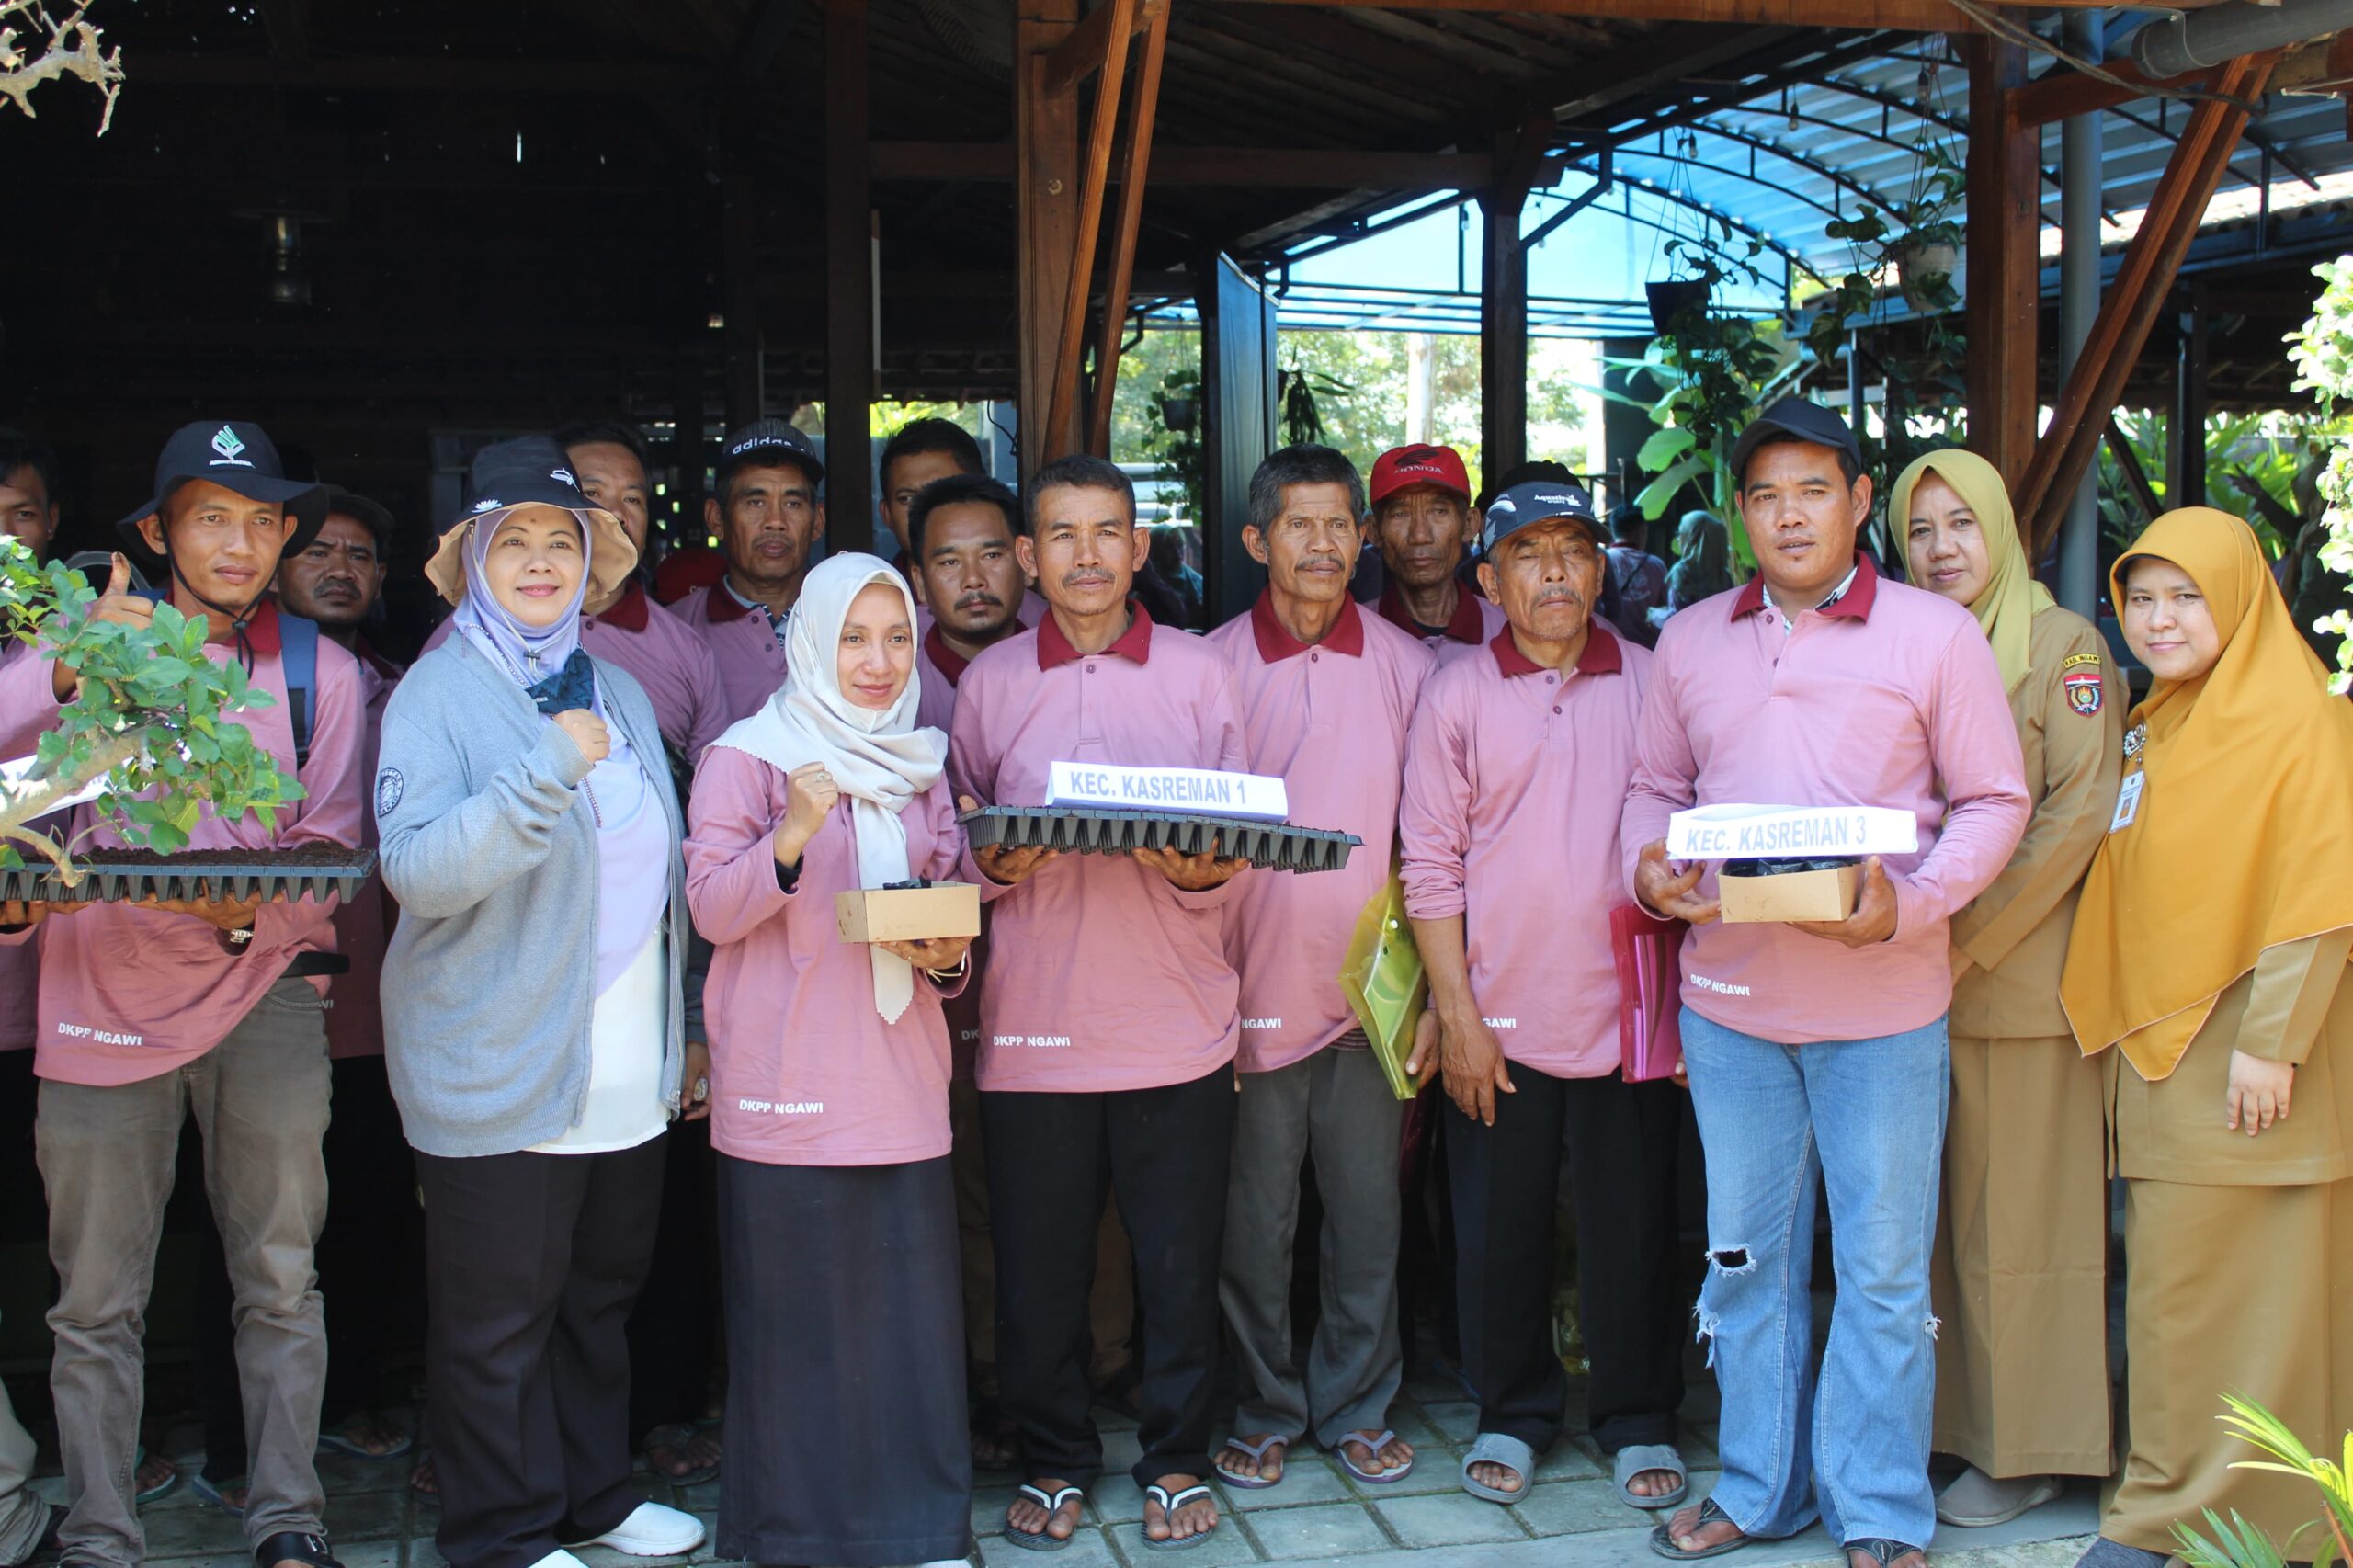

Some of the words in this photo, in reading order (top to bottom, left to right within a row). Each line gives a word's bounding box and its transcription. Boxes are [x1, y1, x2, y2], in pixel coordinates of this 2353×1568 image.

[1070, 771, 1116, 797] KEC.
[1121, 774, 1231, 804] KASREMAN
[1236, 779, 1246, 804] 1
[1685, 828, 1731, 852] KEC.
[1738, 815, 1848, 851] KASREMAN
[1855, 815, 1867, 845] 3
[1711, 981, 1751, 996] NGAWI
[1241, 1017, 1282, 1029] NGAWI
[1482, 1017, 1517, 1029] GAWI
[58, 1022, 92, 1038] DKPP
[94, 1029, 142, 1046] NGAWI
[994, 1036, 1024, 1046] DKPP
[1027, 1036, 1071, 1047] NGAWI
[739, 1099, 772, 1113] DKPP
[774, 1102, 824, 1114] NGAWI
